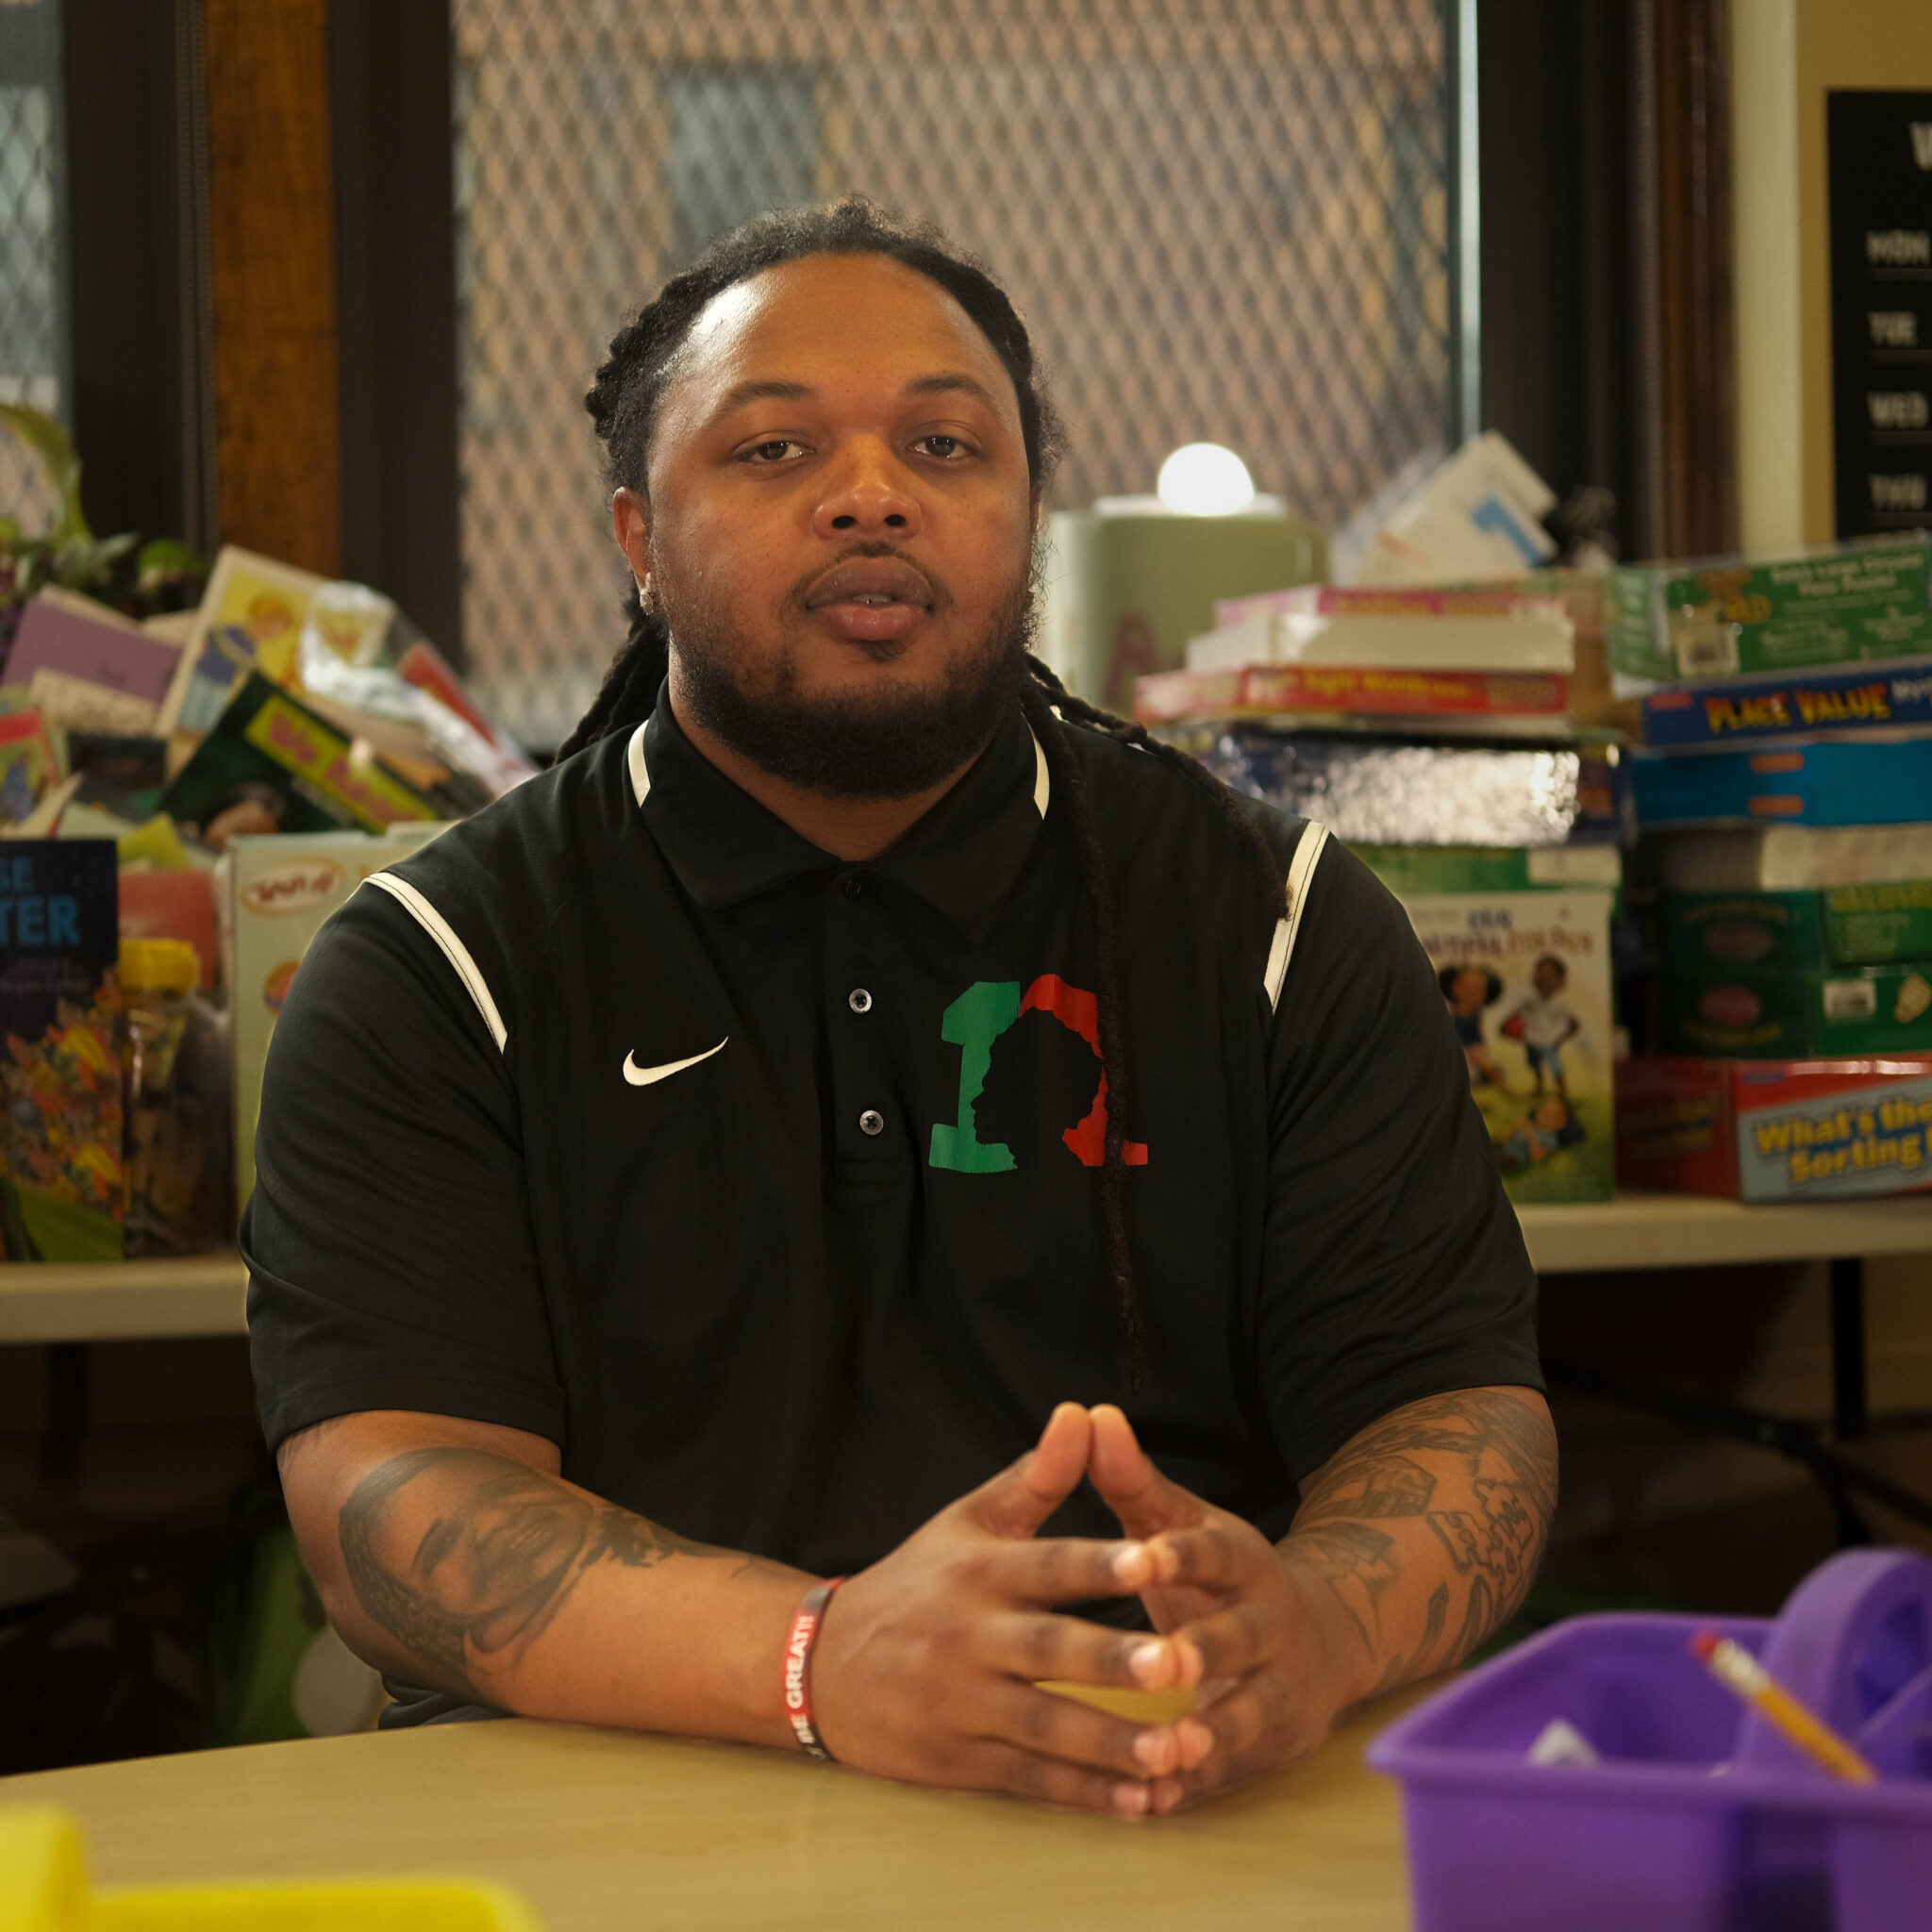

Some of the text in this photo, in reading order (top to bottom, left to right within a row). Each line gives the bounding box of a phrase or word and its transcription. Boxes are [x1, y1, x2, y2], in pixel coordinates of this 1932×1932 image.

[1868, 391, 1927, 429] WED
[1704, 691, 1790, 734] PLACE
[1794, 681, 1890, 724] VALUE
[1756, 1111, 1875, 1155] What's
[1790, 1132, 1922, 1182] Sorting
[791, 1712, 815, 1744] BE
